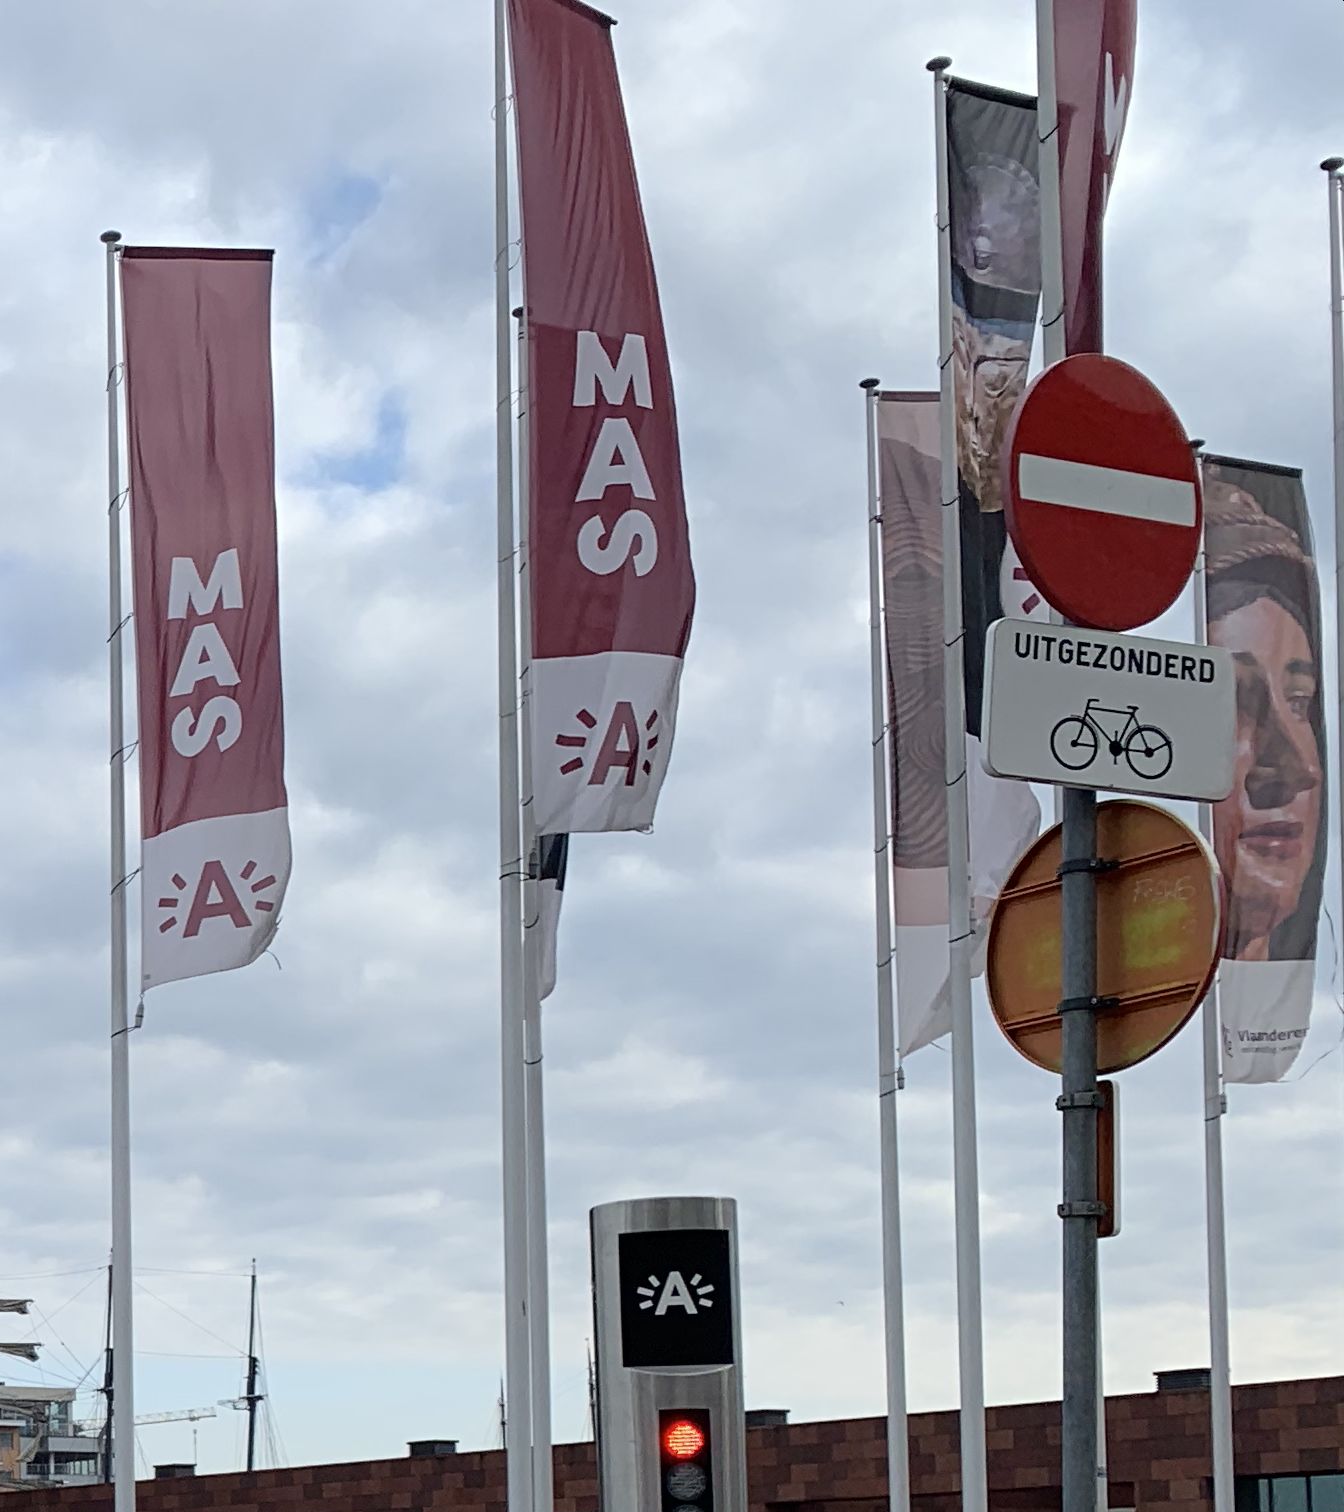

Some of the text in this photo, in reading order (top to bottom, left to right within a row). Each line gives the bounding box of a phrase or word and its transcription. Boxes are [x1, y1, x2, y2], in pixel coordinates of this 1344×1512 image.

[573, 331, 658, 577] MAS
[167, 548, 243, 757] MAS
[1014, 632, 1216, 684] UITGEZONDERD
